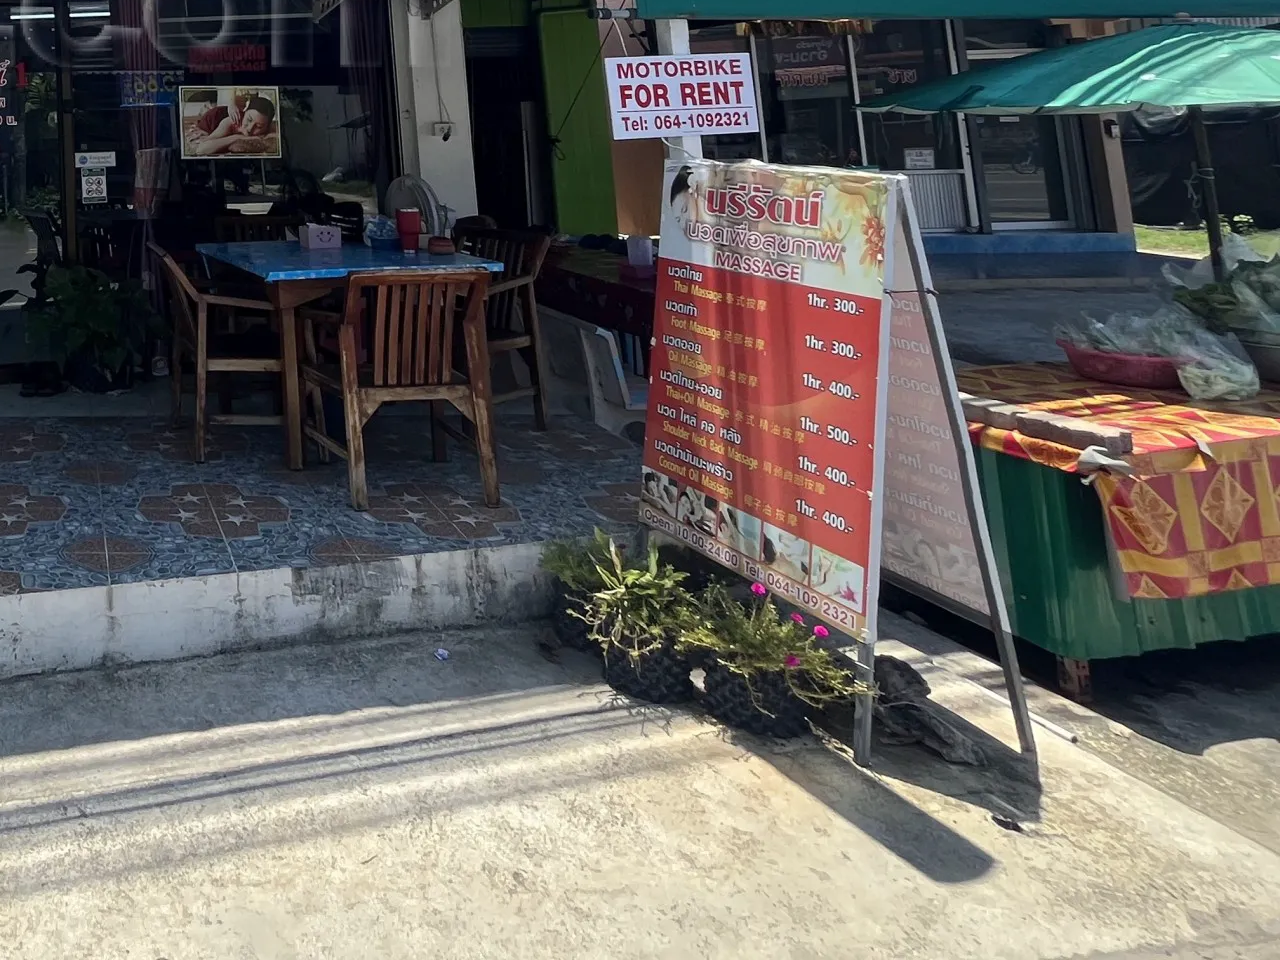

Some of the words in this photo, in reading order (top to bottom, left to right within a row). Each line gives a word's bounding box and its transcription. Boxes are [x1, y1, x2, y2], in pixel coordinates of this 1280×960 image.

[616, 59, 743, 79] MOTORBIKE
[619, 84, 670, 108] FOR
[680, 81, 744, 106] RENT
[622, 117, 648, 131] Tel:
[655, 111, 749, 129] 064-1092321
[705, 184, 825, 229] นรีรัตน์
[687, 221, 841, 262] นวดเพื่อสุขภาพ
[668, 265, 702, 281] นวดไทย
[715, 251, 801, 282] MASSAGE
[674, 280, 688, 293] Thai
[691, 284, 723, 303] Massage
[807, 293, 829, 310] 1hr.
[833, 298, 864, 315] 300.-
[671, 315, 687, 330] Foot
[689, 320, 721, 340] Massage
[662, 334, 701, 354] นวดออย
[805, 335, 827, 352] 1hr.
[831, 341, 862, 359] 300.-
[668, 350, 678, 361] Oil
[680, 354, 712, 375] Massage
[802, 373, 824, 391] 1hr.
[829, 381, 860, 400] 400.-
[697, 397, 730, 419] Massage
[657, 403, 676, 419] นวด
[700, 420, 716, 434] คอ
[719, 427, 742, 445] หลัง
[800, 416, 822, 435] 1hr.
[827, 424, 858, 446] 500.-
[663, 420, 690, 439] Shoulder
[709, 440, 725, 455] Back
[727, 446, 759, 470] Massage
[658, 454, 687, 477] Coconut
[689, 468, 700, 482] Oil
[701, 473, 734, 500] Massage
[798, 456, 820, 476] 1hr.
[824, 466, 856, 488] 400.-
[795, 499, 818, 520] 1hr.
[821, 511, 853, 534] 400.-
[644, 508, 674, 532] Open:
[676, 525, 739, 567] 10.00-24.00
[744, 560, 764, 581] Tel:
[766, 571, 819, 609] 064-109
[823, 601, 856, 630] 2321
